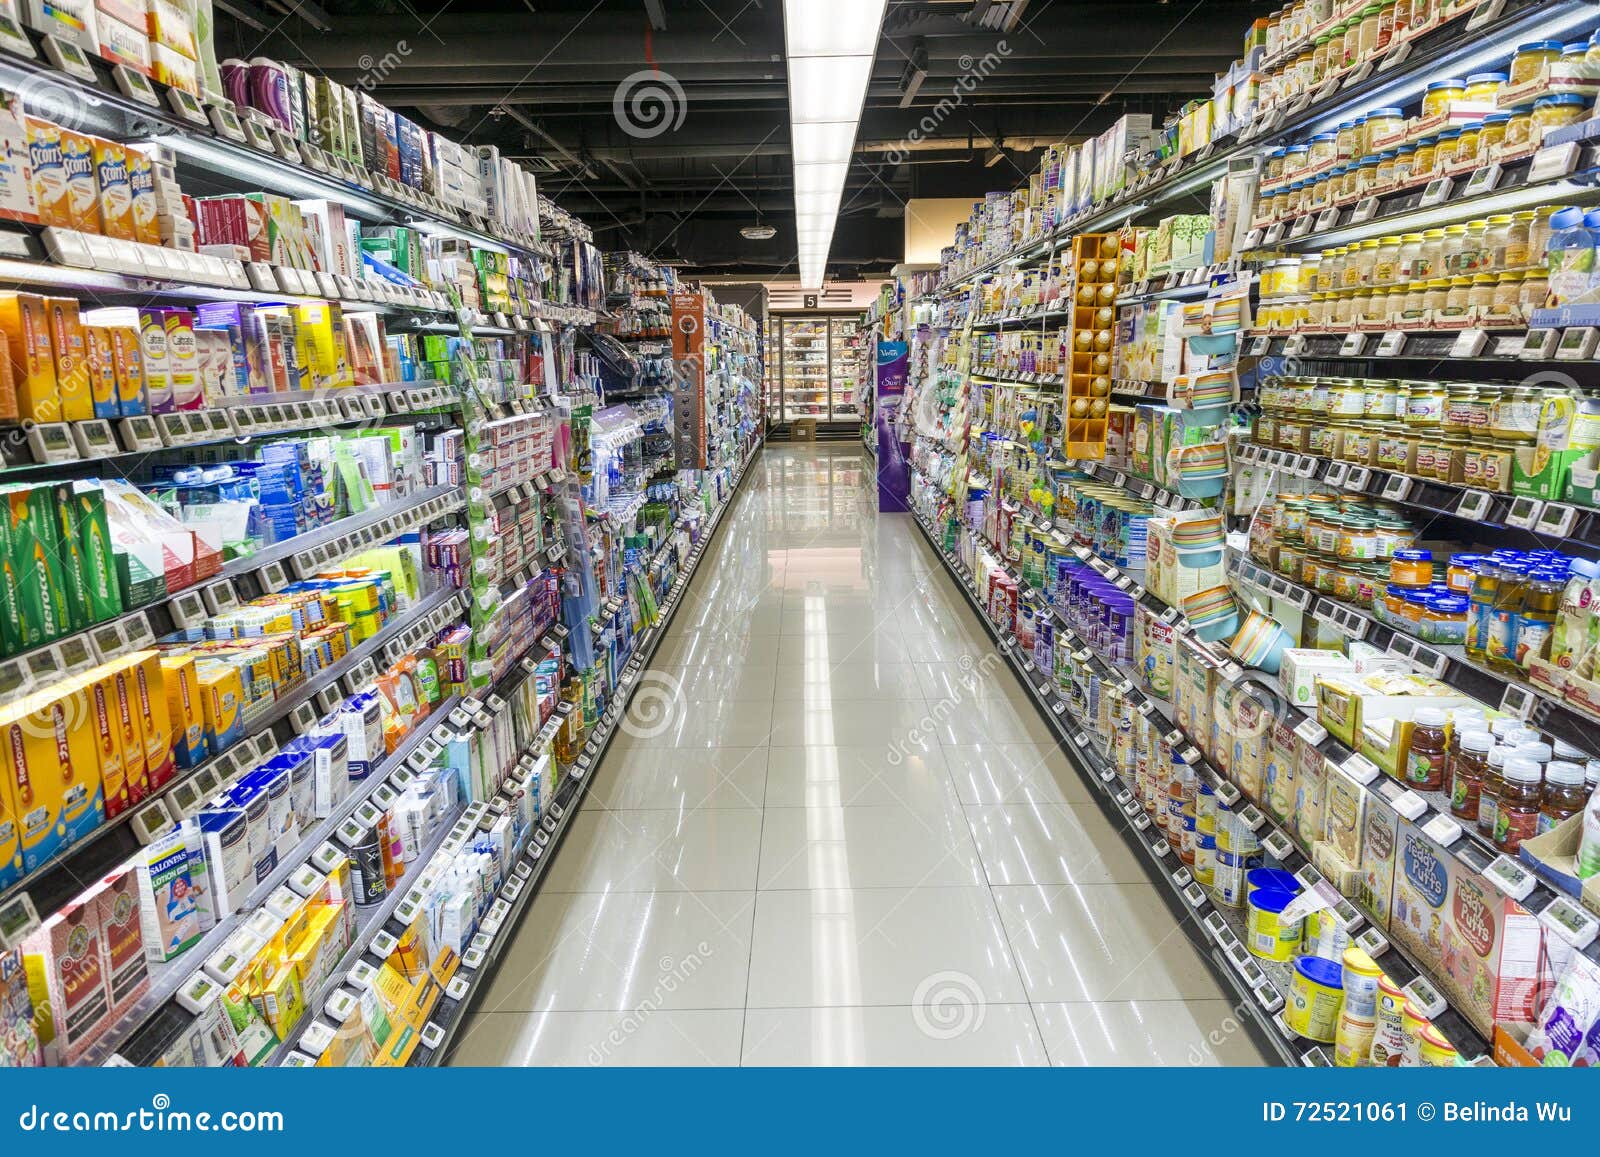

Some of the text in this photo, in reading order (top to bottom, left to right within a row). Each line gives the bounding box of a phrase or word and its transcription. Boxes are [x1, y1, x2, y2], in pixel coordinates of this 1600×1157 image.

[807, 296, 815, 307] 5
[36, 560, 55, 635] Berocca
[12, 729, 28, 784] Redoxon
[150, 850, 187, 876] SALONPAS
[1406, 833, 1437, 873] Teddy
[152, 869, 177, 888] LOTION
[1412, 858, 1442, 895] Puffs
[1456, 877, 1485, 917] Teddy
[1461, 902, 1489, 942] Puffs
